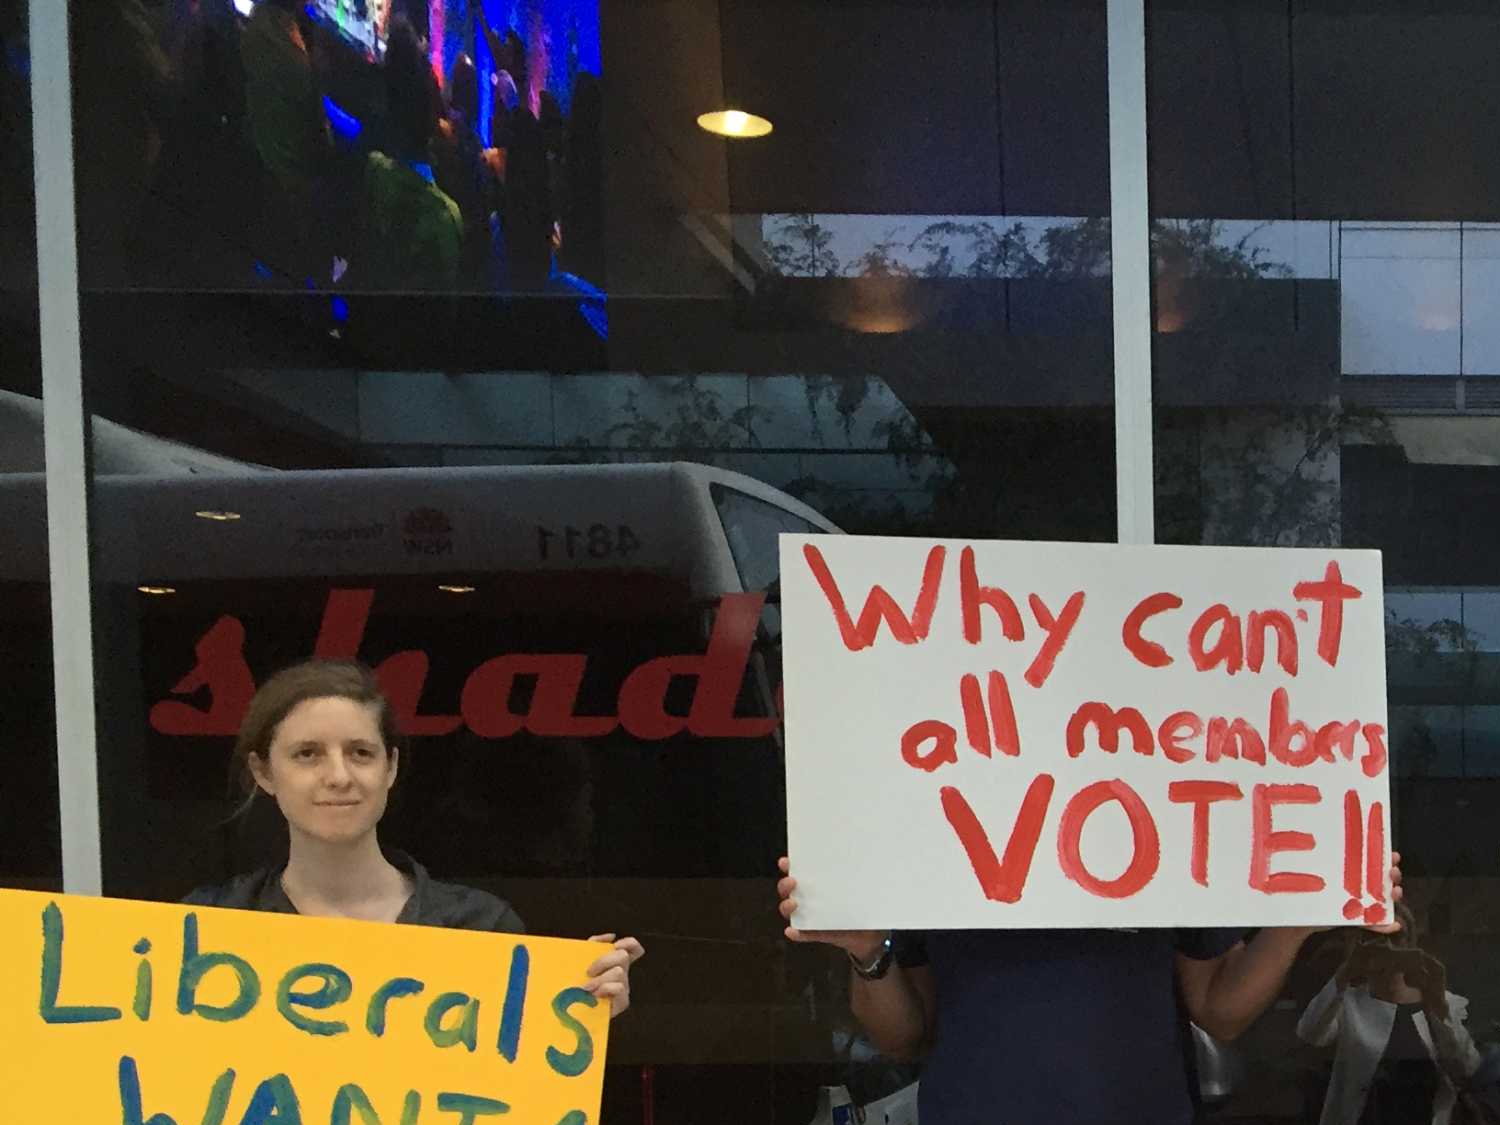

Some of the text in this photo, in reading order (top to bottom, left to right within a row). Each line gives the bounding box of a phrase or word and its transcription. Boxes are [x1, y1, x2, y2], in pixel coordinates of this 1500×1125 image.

[149, 588, 783, 740] shad
[803, 543, 1362, 688] Why can't
[900, 670, 1388, 778] all members
[940, 773, 1386, 925] VOTE!!
[39, 901, 600, 1077] Liberals
